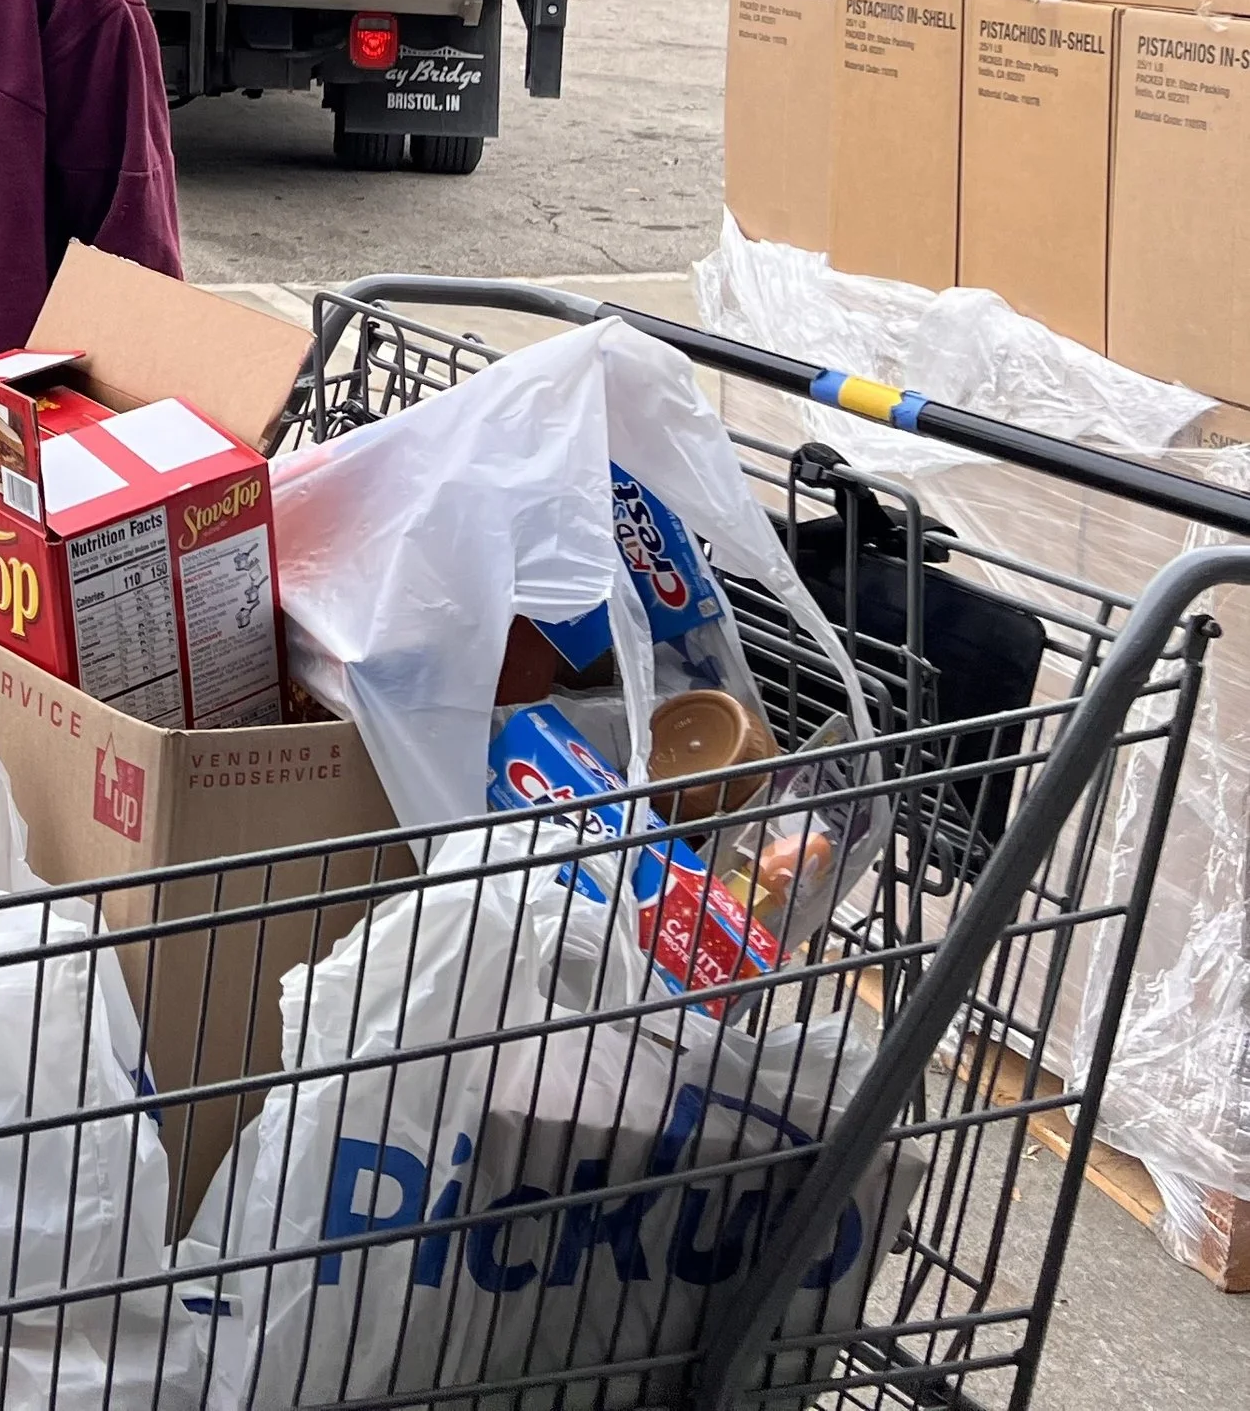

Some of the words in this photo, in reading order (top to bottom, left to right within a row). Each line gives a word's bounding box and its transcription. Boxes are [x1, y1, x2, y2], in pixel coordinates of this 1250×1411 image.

[906, 7, 957, 30] IN-SHELL
[979, 19, 1047, 46] PISTACHIOS
[1049, 29, 1105, 54] IN-SHELL
[1137, 35, 1216, 64] PISTACHIOS
[385, 68, 409, 88] ay
[409, 59, 482, 90] Bridge
[387, 92, 443, 112] BRISTOL,
[446, 94, 461, 112] IN
[70, 528, 126, 559] Nutrition
[130, 513, 163, 537] Facts
[124, 572, 141, 590] 110
[151, 562, 168, 579] 150
[76, 590, 105, 608] Calories
[192, 747, 311, 769] VENDING
[330, 744, 341, 759] &
[190, 764, 342, 788] FOODSERVICE
[113, 788, 138, 835] up
[666, 918, 729, 983] CAITY
